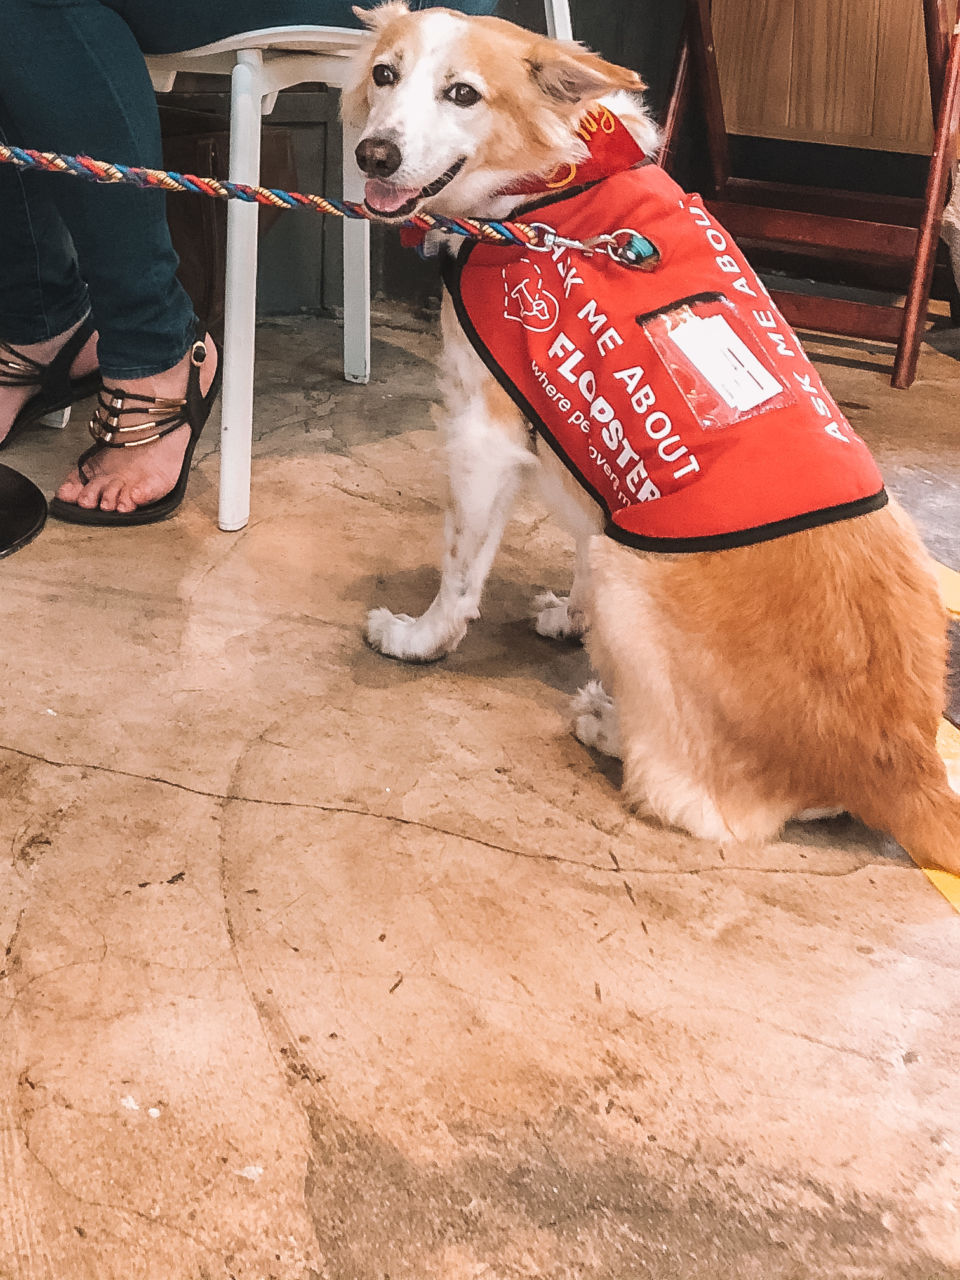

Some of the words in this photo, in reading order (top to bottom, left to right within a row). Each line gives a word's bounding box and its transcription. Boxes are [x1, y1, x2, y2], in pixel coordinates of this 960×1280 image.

[752, 310, 795, 357] ME
[531, 360, 571, 412] where
[567, 410, 590, 433] pe
[548, 332, 661, 503] FLOPSTER
[577, 299, 624, 357] ME
[612, 366, 701, 480] ABOUT
[791, 371, 850, 443] ASK
